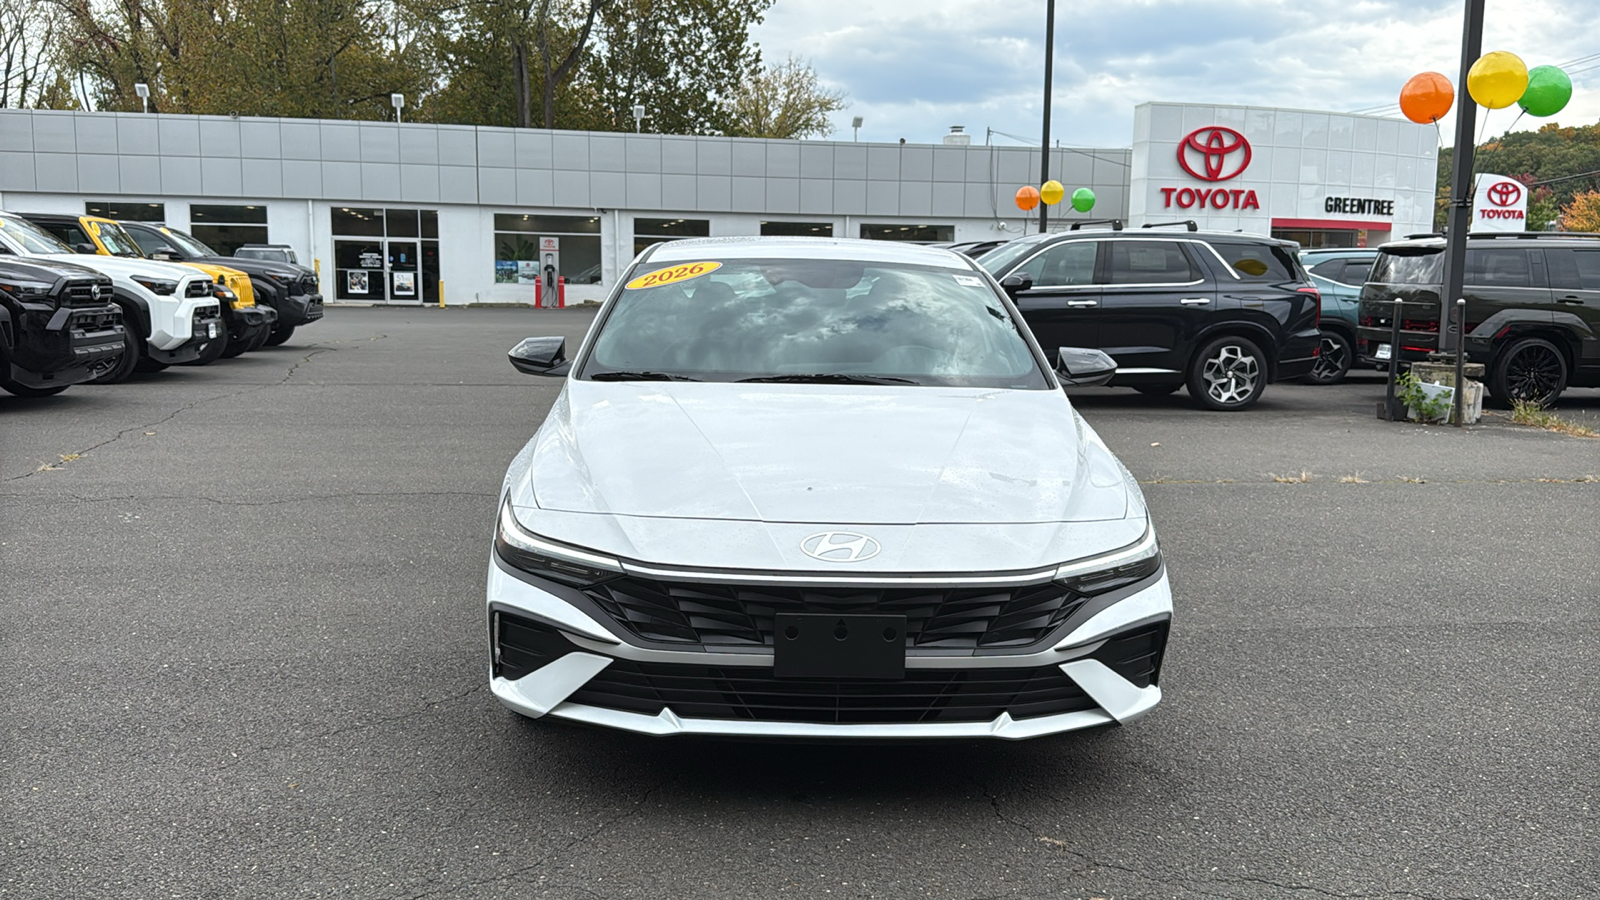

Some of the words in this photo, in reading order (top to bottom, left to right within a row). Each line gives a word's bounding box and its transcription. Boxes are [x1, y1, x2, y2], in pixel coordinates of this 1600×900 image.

[1161, 187, 1260, 210] TOYOTA
[1325, 196, 1394, 216] GREENTREE
[1480, 209, 1525, 220] TOYOTA
[643, 263, 704, 287] 2026
